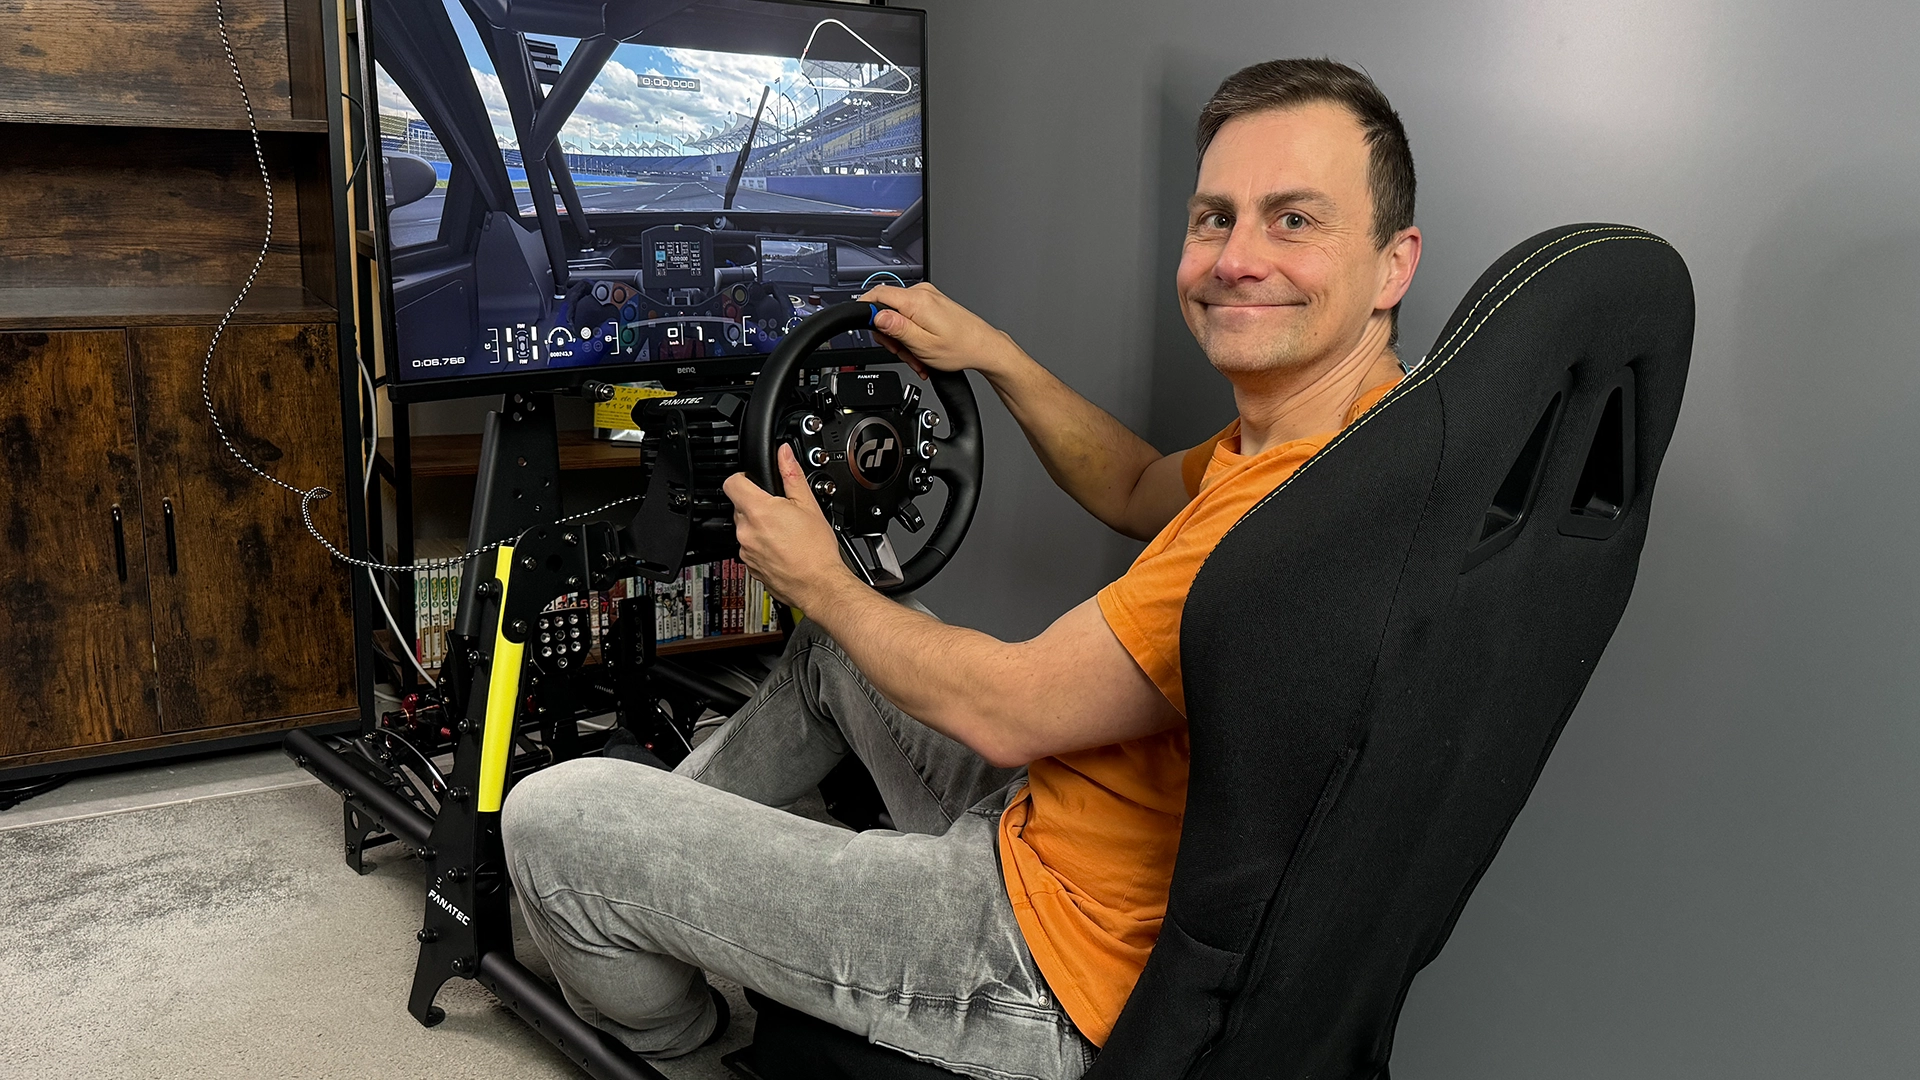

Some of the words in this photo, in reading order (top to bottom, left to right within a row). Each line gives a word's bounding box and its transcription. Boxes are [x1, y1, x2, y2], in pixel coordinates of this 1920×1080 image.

[667, 327, 679, 338] 0
[697, 325, 703, 341] 1
[867, 382, 874, 395] 0
[659, 396, 704, 406] FANATEC
[428, 889, 470, 926] FANATEC
